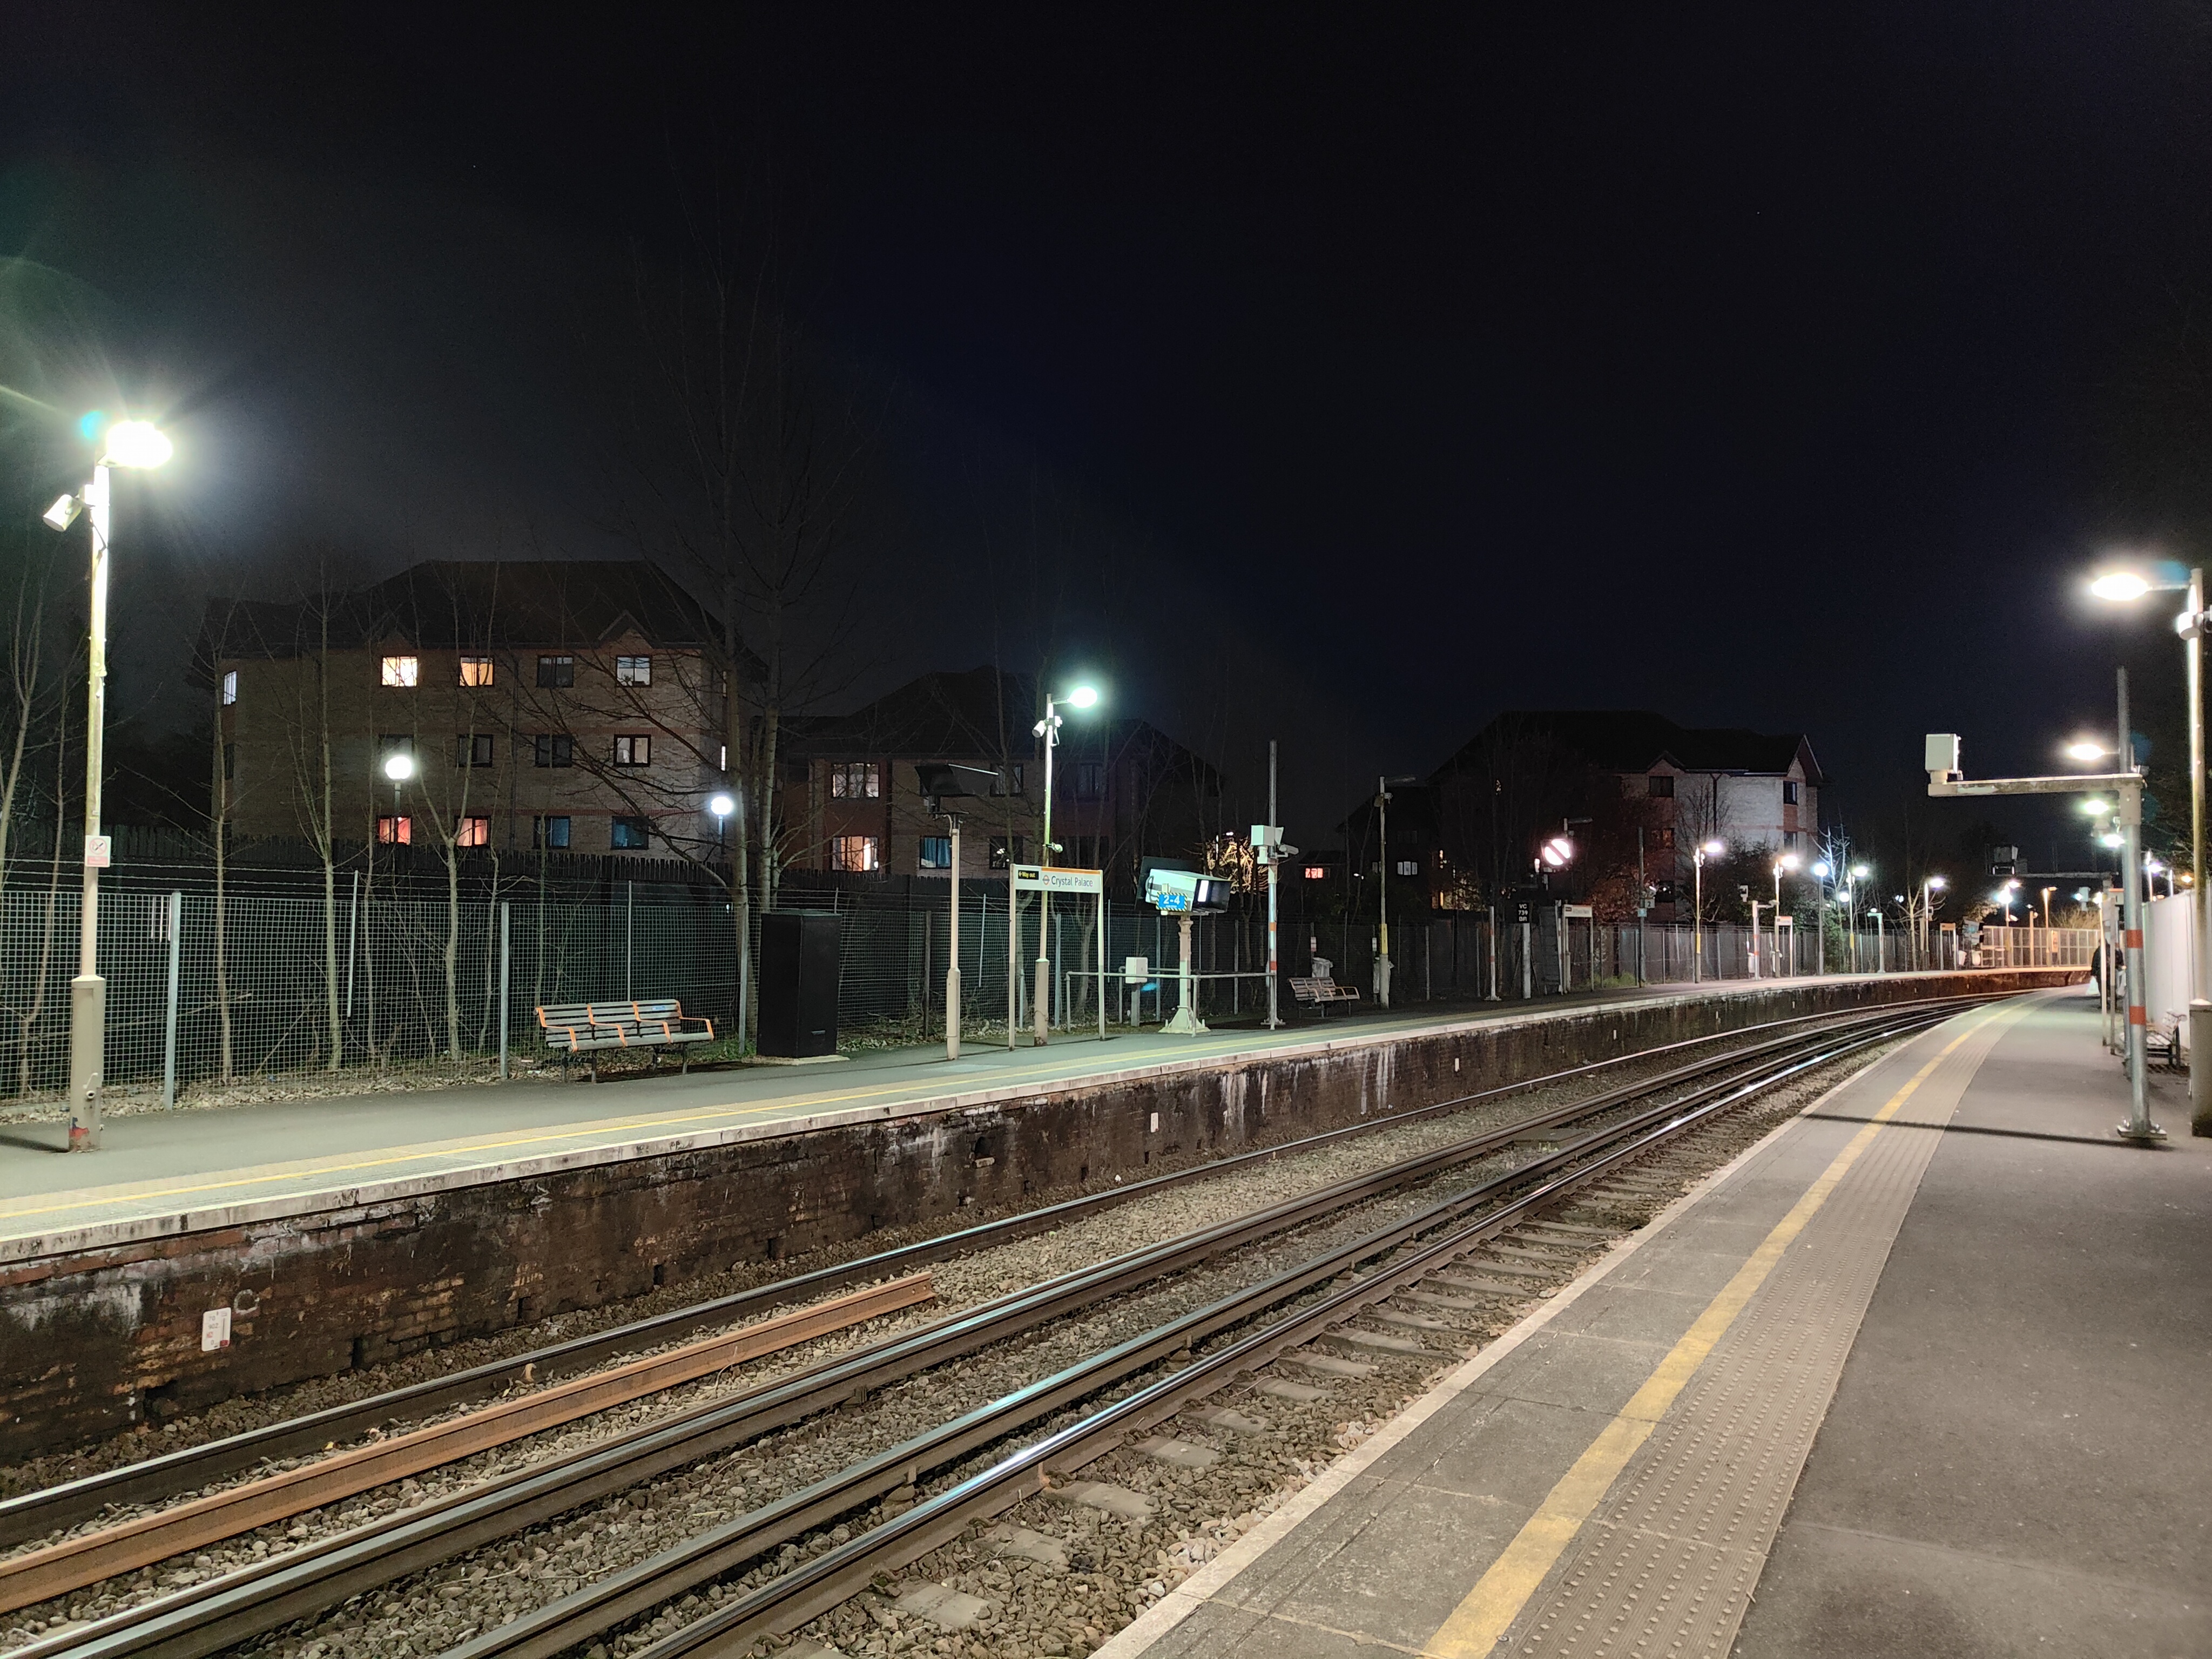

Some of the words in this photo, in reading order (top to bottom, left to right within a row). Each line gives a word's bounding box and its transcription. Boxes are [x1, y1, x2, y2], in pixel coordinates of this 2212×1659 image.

[1051, 875, 1073, 887] Crystal
[1075, 877, 1093, 887] Palace
[1163, 895, 1180, 905] 2-4
